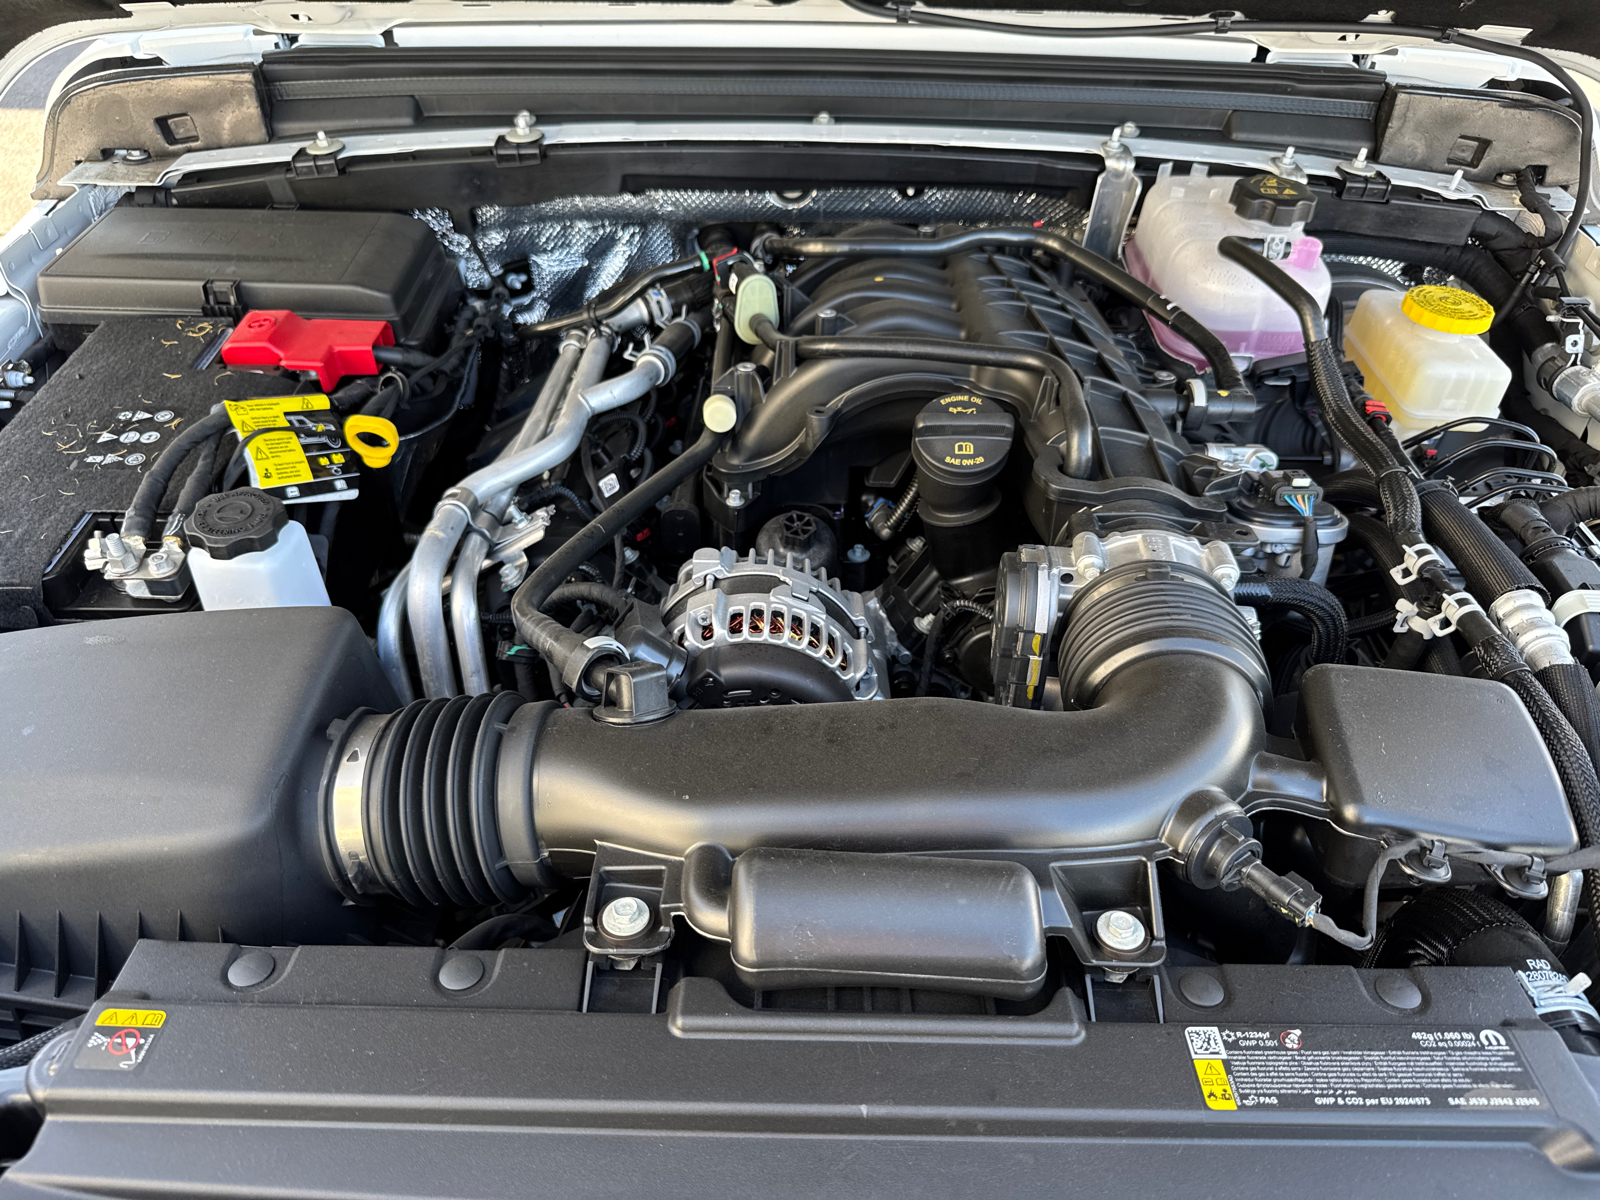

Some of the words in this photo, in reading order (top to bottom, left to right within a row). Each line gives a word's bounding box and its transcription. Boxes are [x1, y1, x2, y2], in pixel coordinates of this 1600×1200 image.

[940, 395, 970, 406] ENGINE
[970, 396, 983, 406] OIL
[944, 456, 961, 465] SAE
[961, 456, 985, 466] 0W-20
[1526, 958, 1551, 970] RAD
[1235, 1031, 1270, 1040] R-1234yf
[1258, 1039, 1278, 1047] 0.501
[1437, 1041, 1448, 1049] eq
[1259, 1096, 1278, 1105] PAG
[1314, 1096, 1336, 1105] GWP
[1337, 1096, 1345, 1105] &
[1345, 1096, 1365, 1105] CO2
[1365, 1098, 1379, 1106] per
[1379, 1096, 1394, 1105] EU
[1393, 1096, 1432, 1106] 2024/573
[1447, 1096, 1468, 1106] SAE
